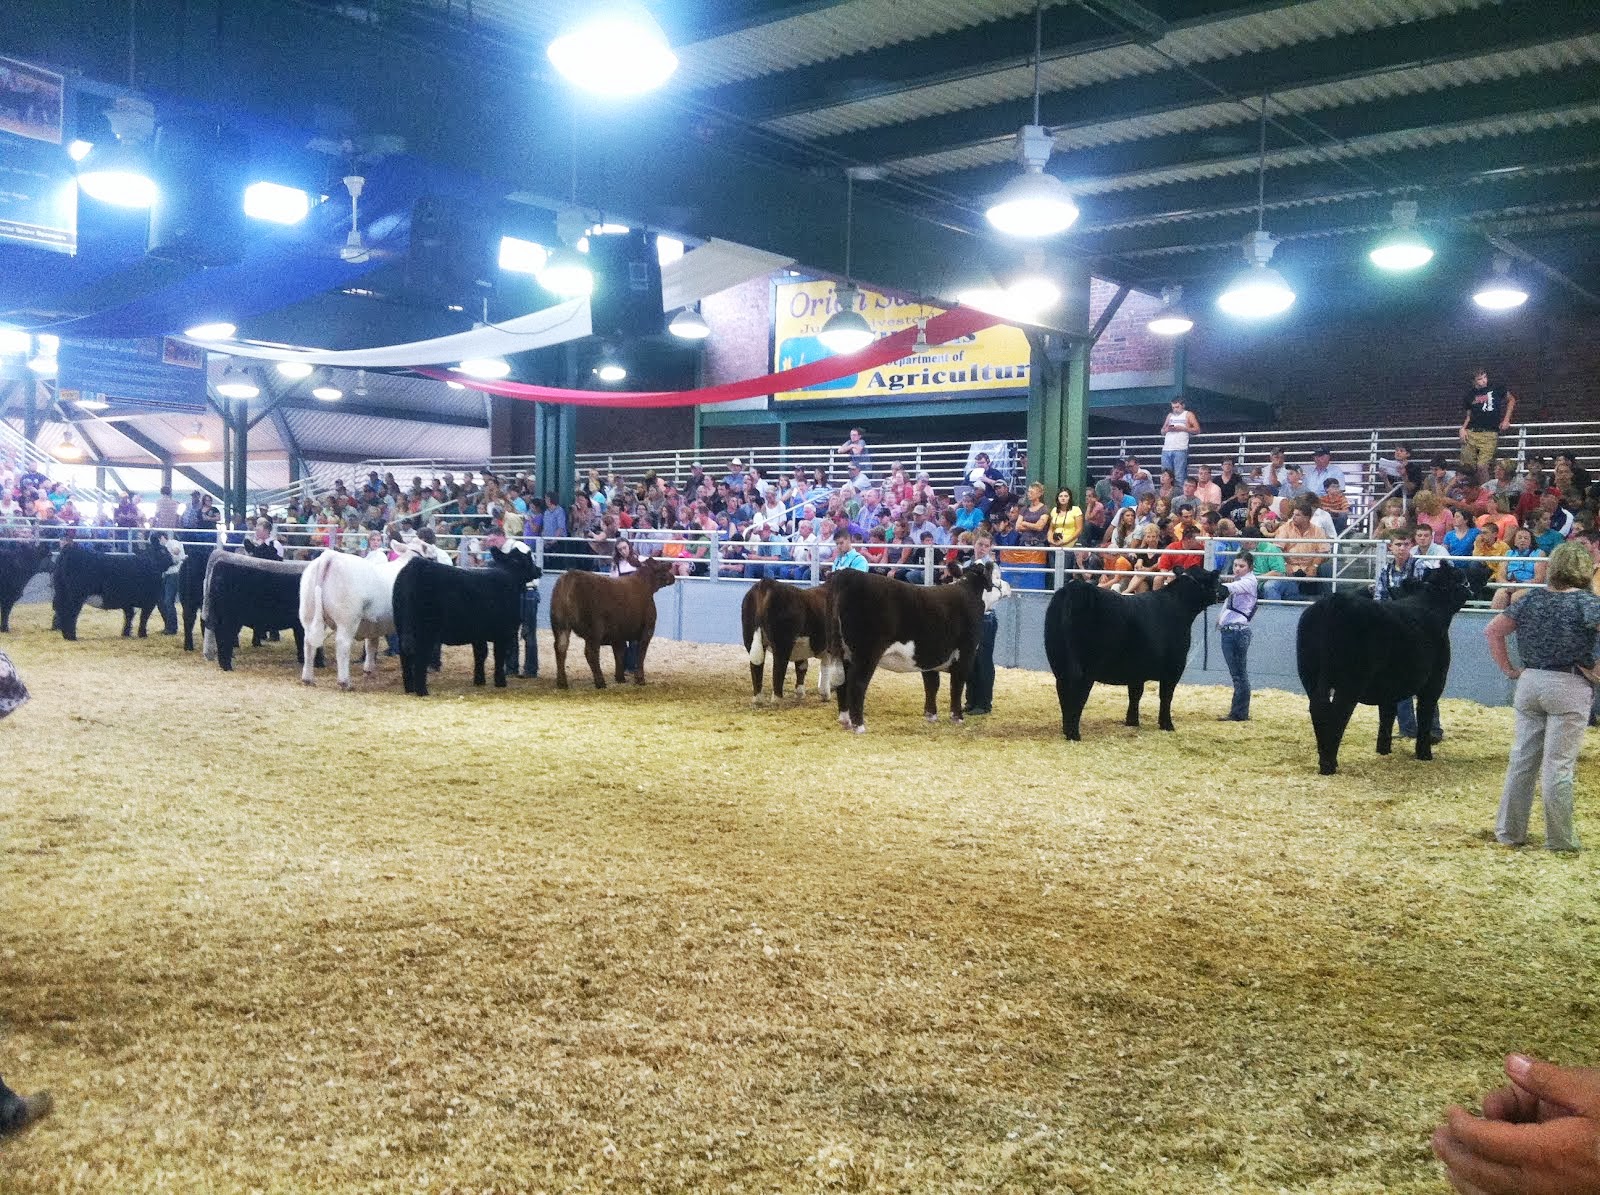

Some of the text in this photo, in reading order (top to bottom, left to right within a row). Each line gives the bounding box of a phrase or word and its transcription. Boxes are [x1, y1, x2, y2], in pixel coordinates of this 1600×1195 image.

[886, 350, 964, 367] epartment of
[868, 364, 1030, 391] Agricultur
